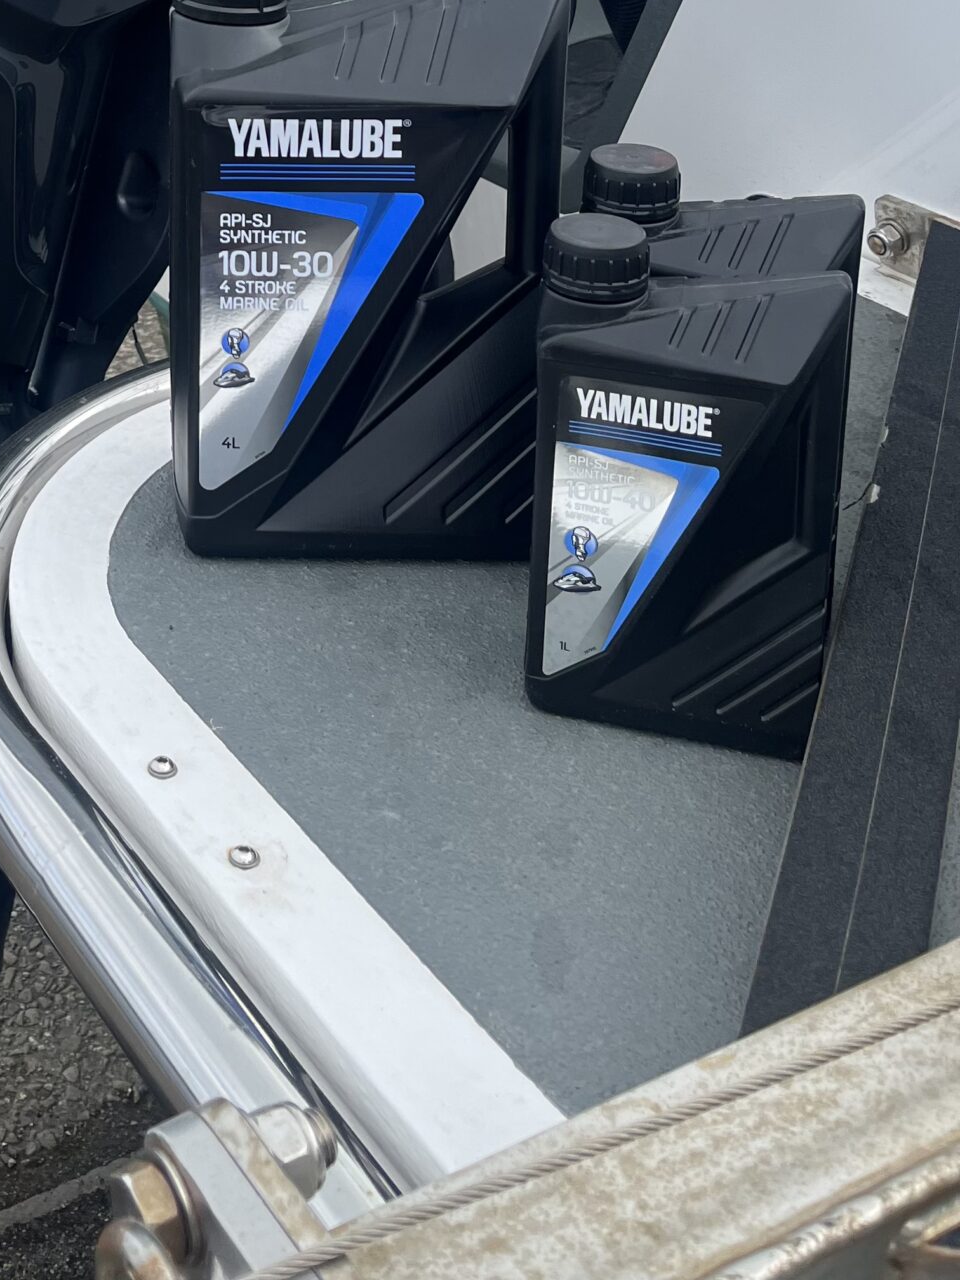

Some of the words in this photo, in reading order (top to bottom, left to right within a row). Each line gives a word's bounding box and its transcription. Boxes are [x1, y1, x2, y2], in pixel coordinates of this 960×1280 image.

[220, 213, 272, 228] API-SJ
[219, 229, 307, 244] SYNTHETIC
[218, 250, 334, 278] 10W-30
[219, 280, 231, 294] 4
[235, 280, 297, 295] STROKE
[220, 297, 280, 311] MARINE
[285, 298, 310, 312] OIL
[221, 436, 241, 450] 4L
[568, 454, 610, 471] API-SJ
[566, 479, 656, 512] 10W-40
[558, 640, 571, 652] 1L
